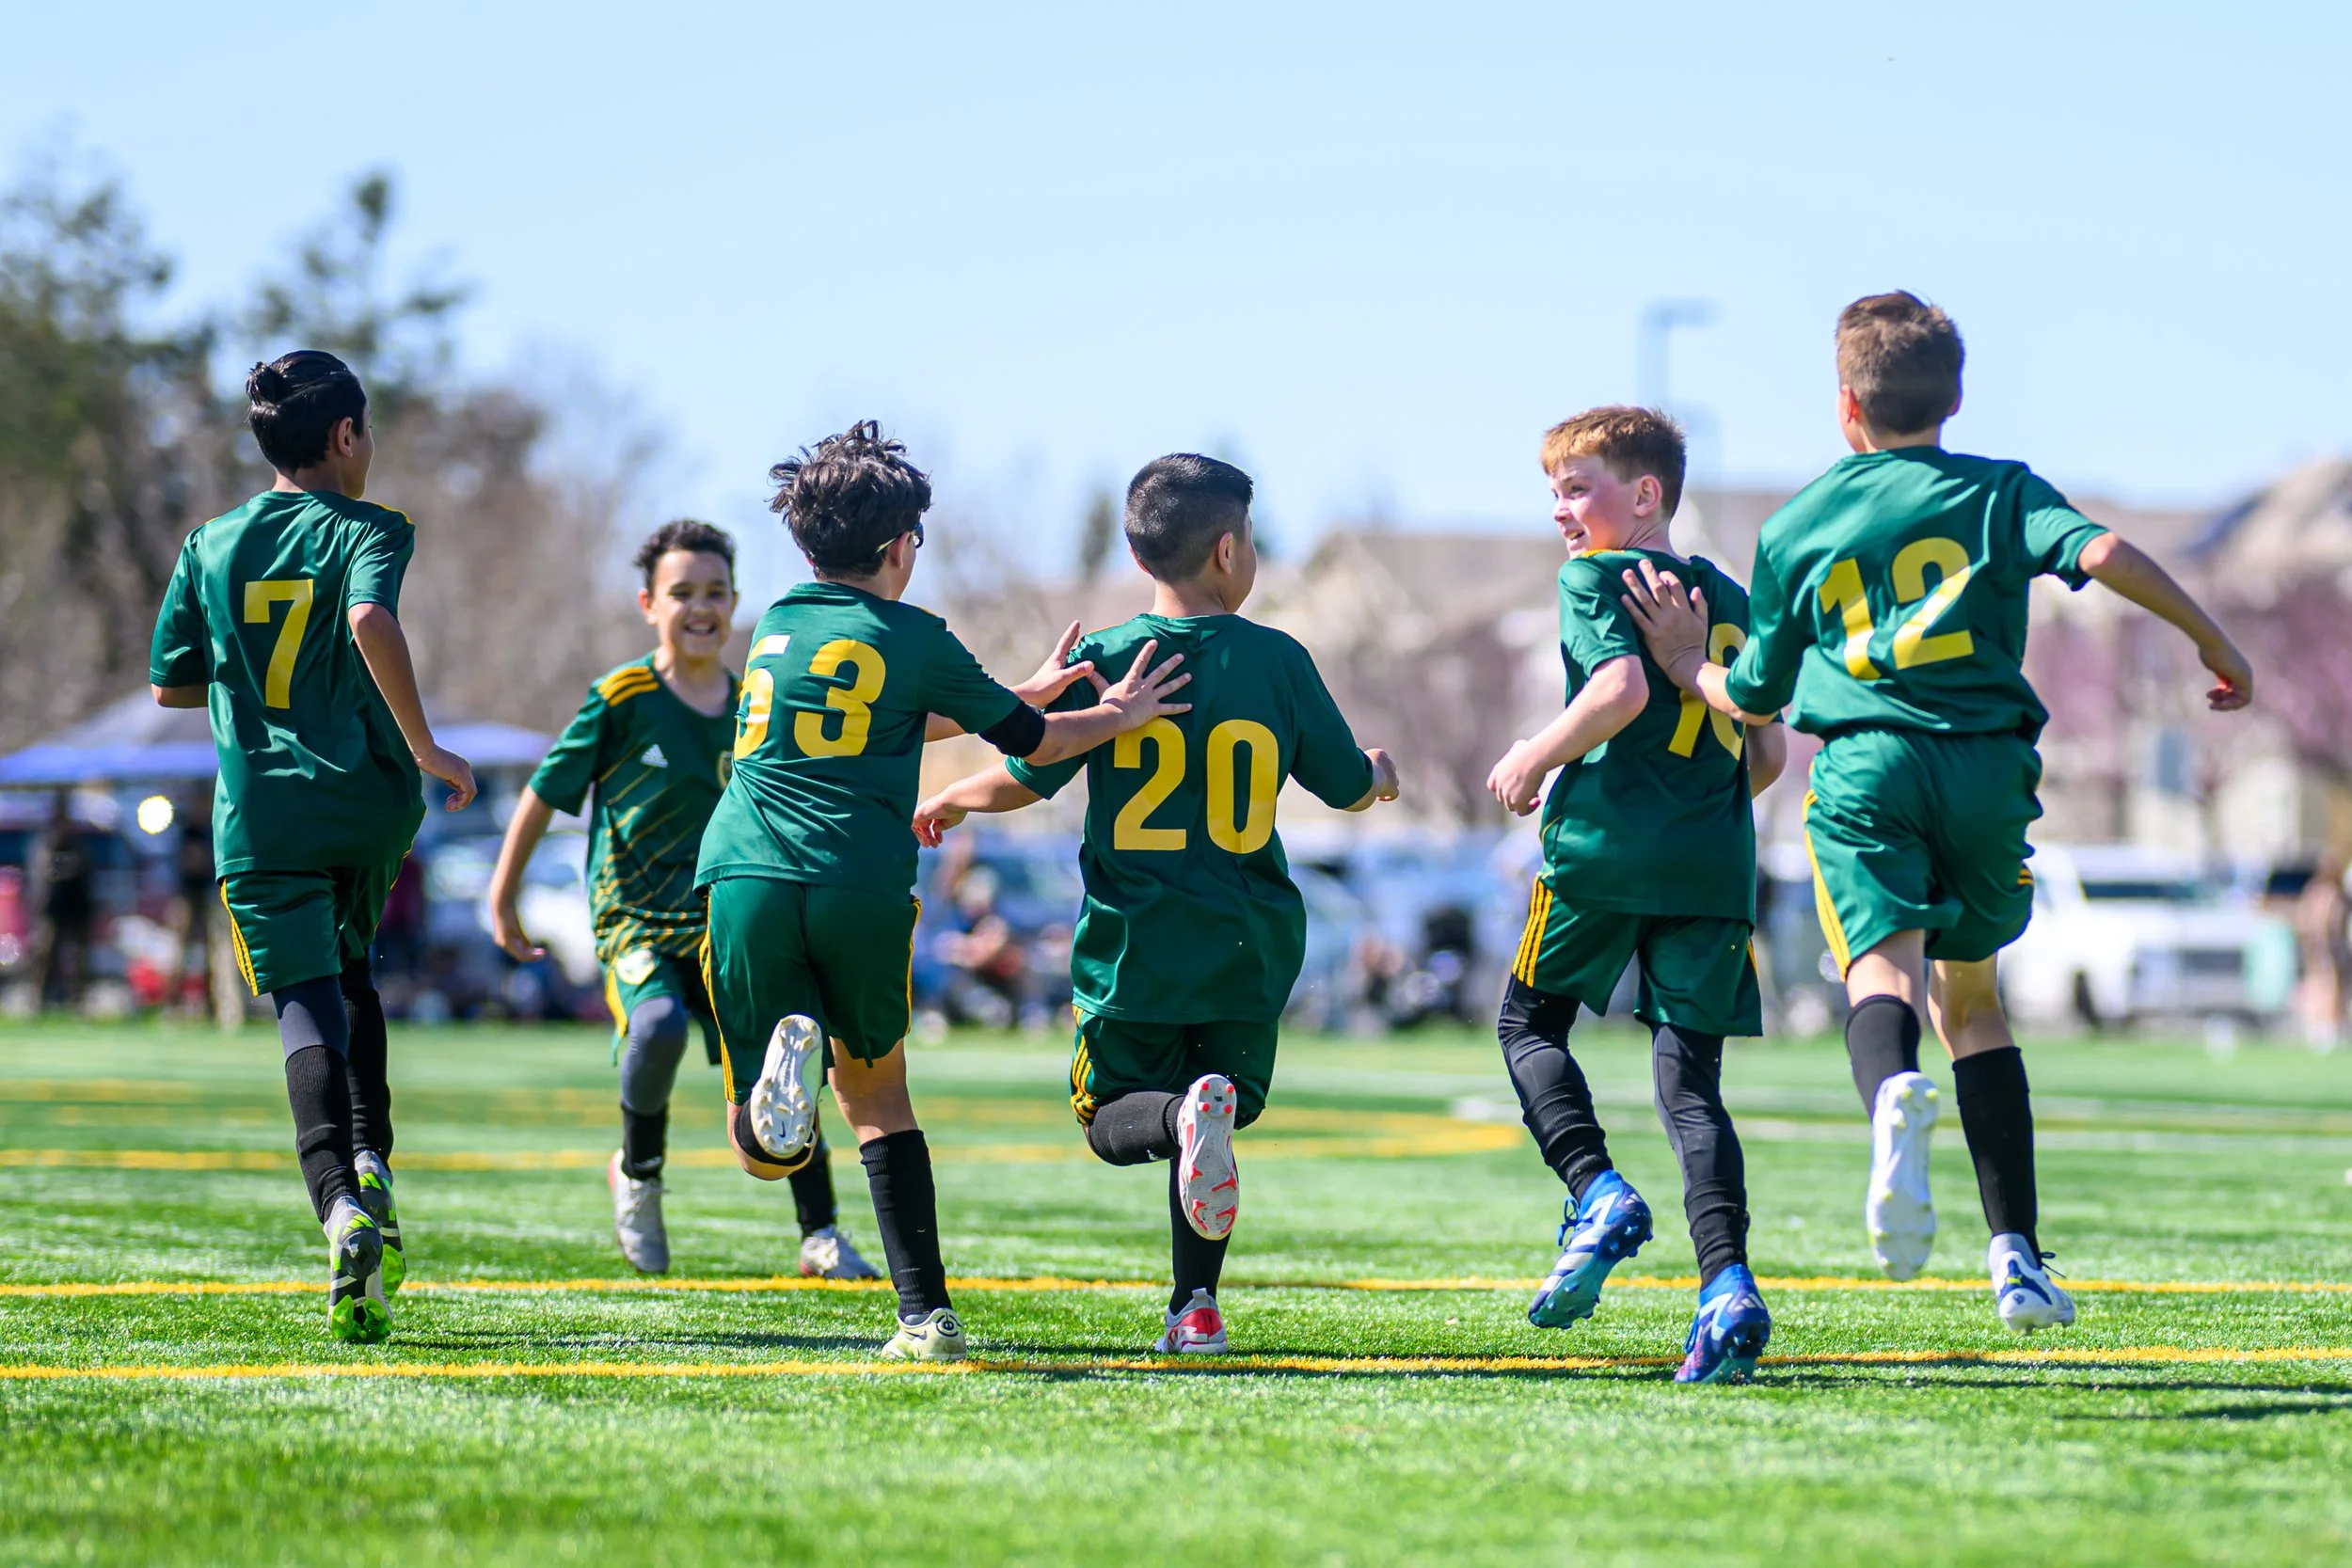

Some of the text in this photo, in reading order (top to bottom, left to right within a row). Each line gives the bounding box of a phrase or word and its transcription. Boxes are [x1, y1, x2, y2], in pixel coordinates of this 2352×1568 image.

[244, 579, 314, 709] 7
[1819, 537, 1975, 681] 12
[1114, 717, 1279, 854] 20
